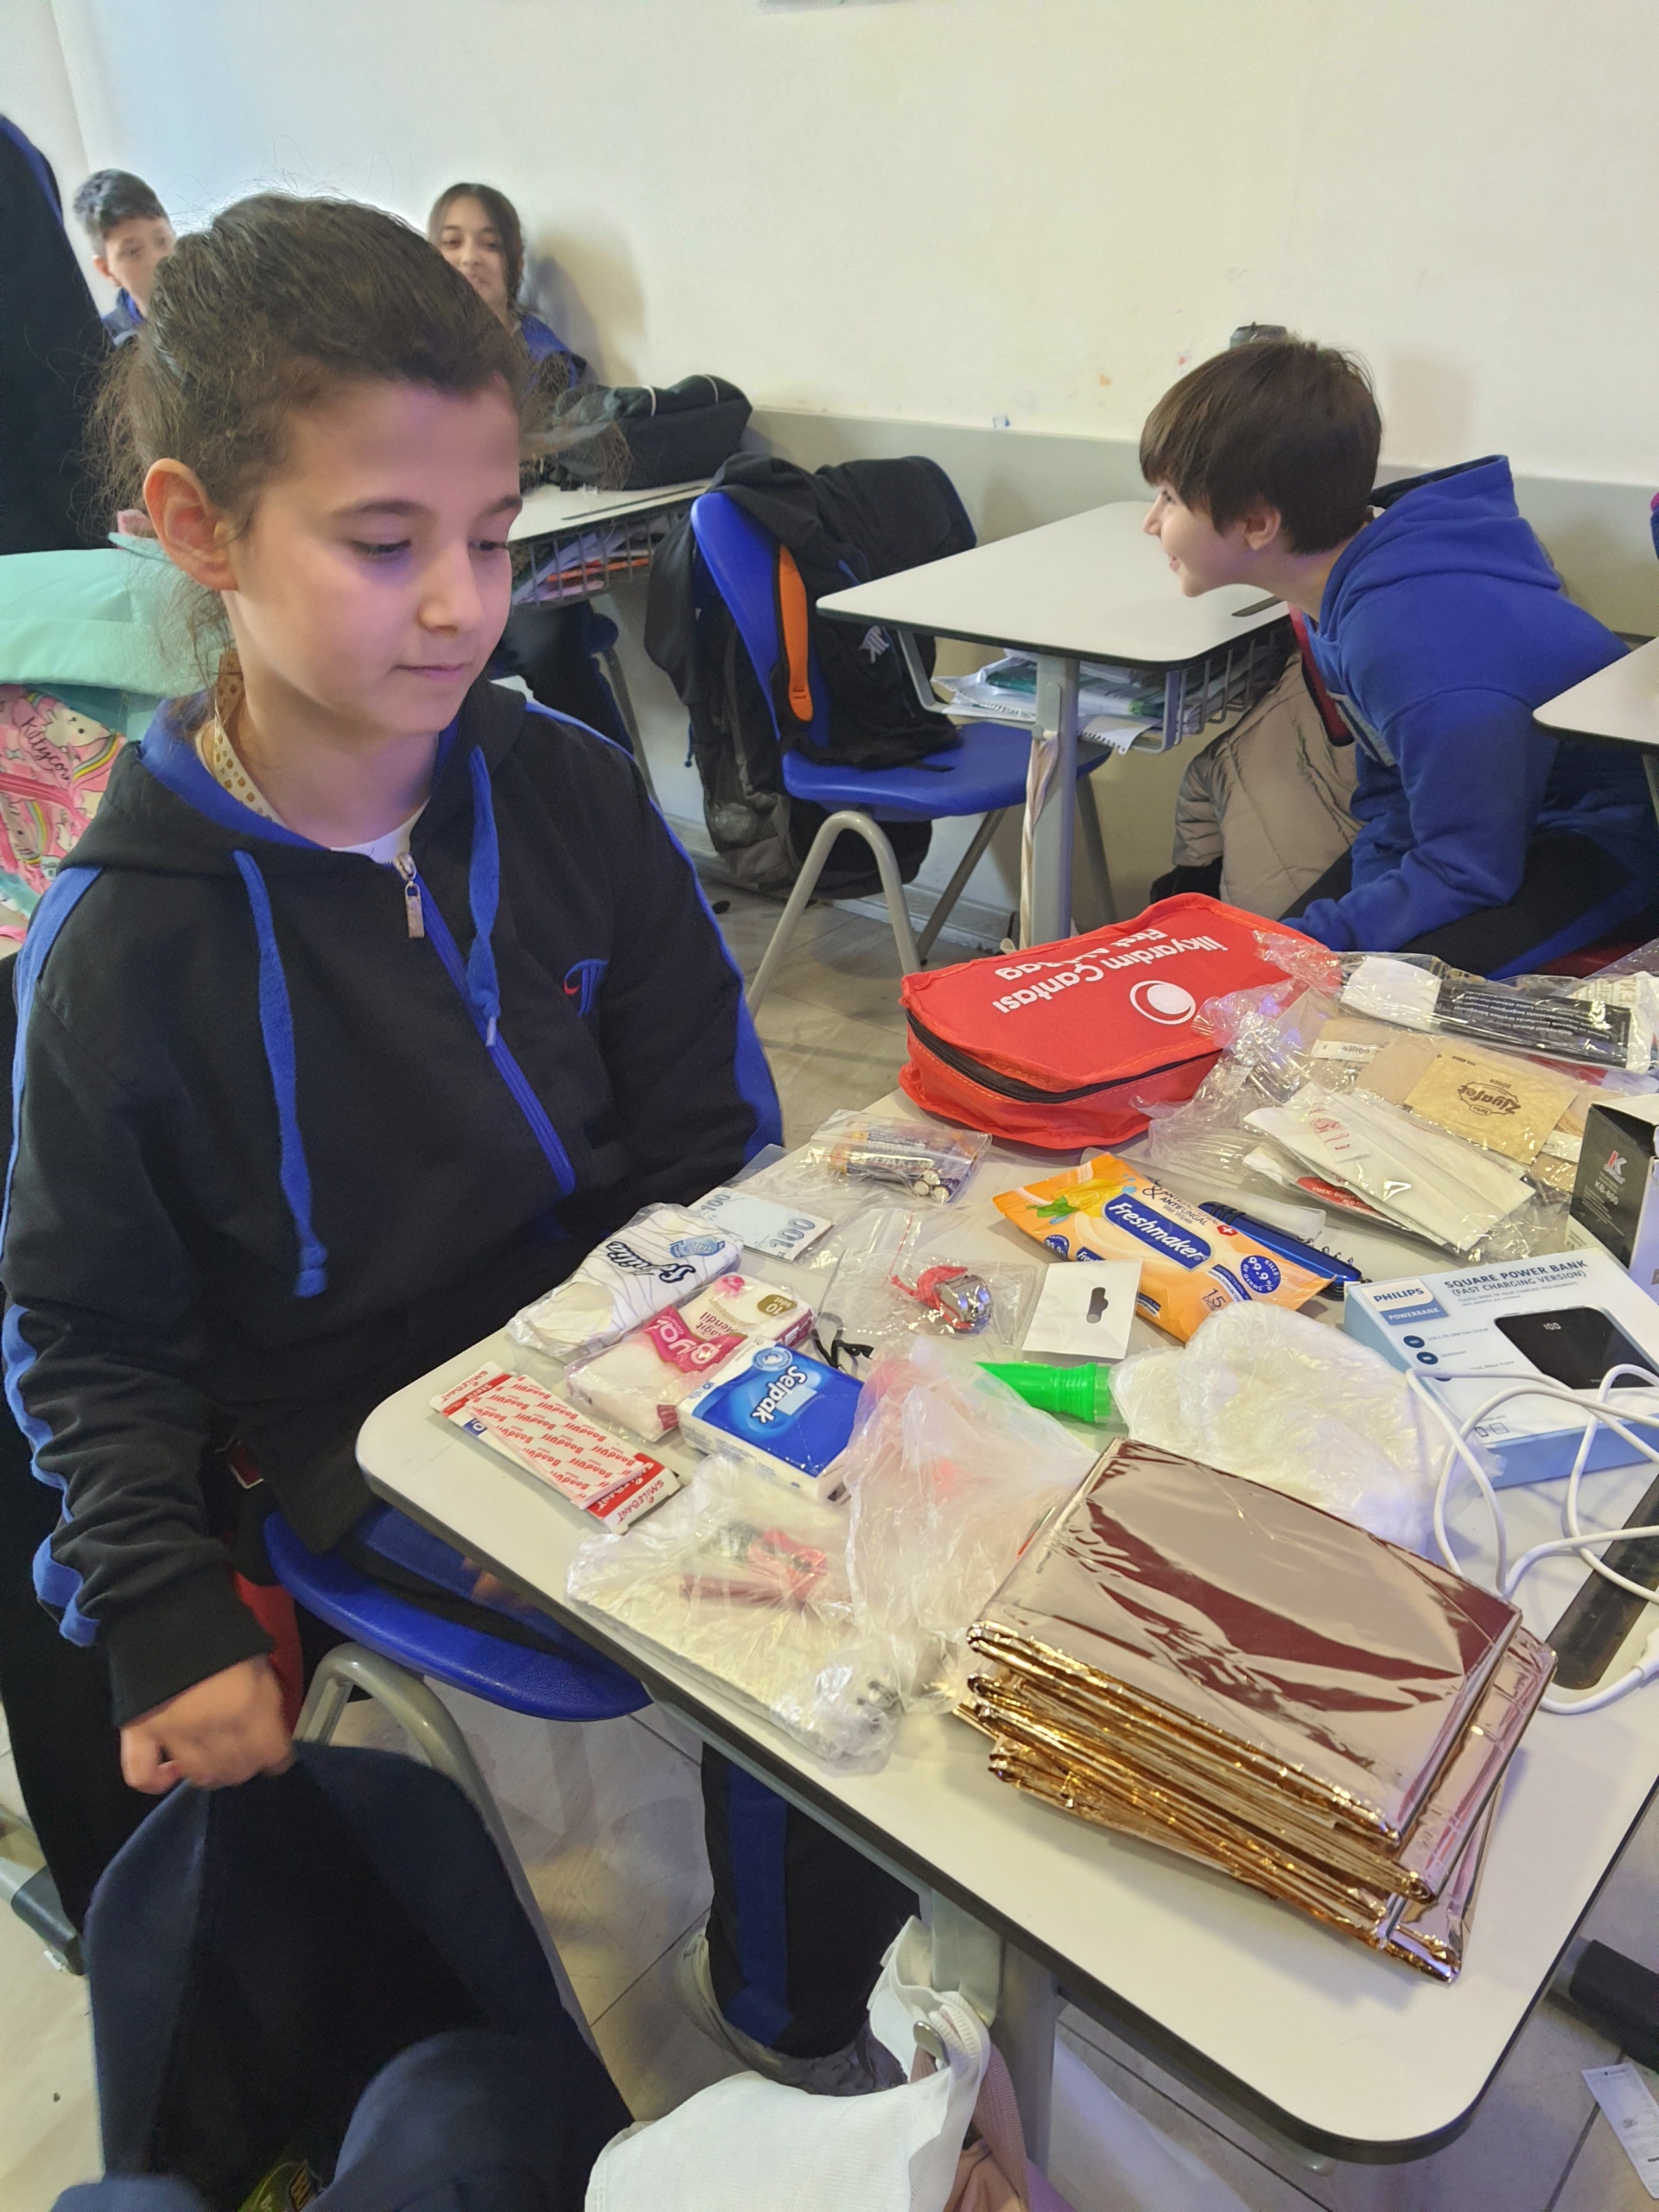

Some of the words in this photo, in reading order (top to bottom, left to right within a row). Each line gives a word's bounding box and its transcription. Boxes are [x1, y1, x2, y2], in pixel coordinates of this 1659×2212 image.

[993, 963, 1103, 1013] Çantası
[700, 1193, 731, 1211] 100
[1594, 1179, 1619, 1205] KB-800
[1160, 1197, 1208, 1227] ANTIFUNGAL
[769, 1217, 816, 1250] 100
[1109, 1203, 1205, 1259] Freshmaker
[1247, 1256, 1274, 1291] 99.9%
[1264, 1259, 1280, 1276] KILLS
[1444, 1274, 1500, 1290] SQUARE
[1501, 1265, 1550, 1281] POWER
[1552, 1260, 1589, 1274] BANK
[1373, 1287, 1425, 1303] PHILIPS
[1451, 1285, 1481, 1297] (FAST
[1484, 1276, 1537, 1292] CHARGING
[1538, 1269, 1587, 1285] VERSION)
[766, 1303, 784, 1315] 10
[776, 1297, 794, 1308] adet
[1207, 1287, 1226, 1308] 15
[1388, 1306, 1441, 1322] POWERBANK
[751, 1364, 807, 1424] Selpak
